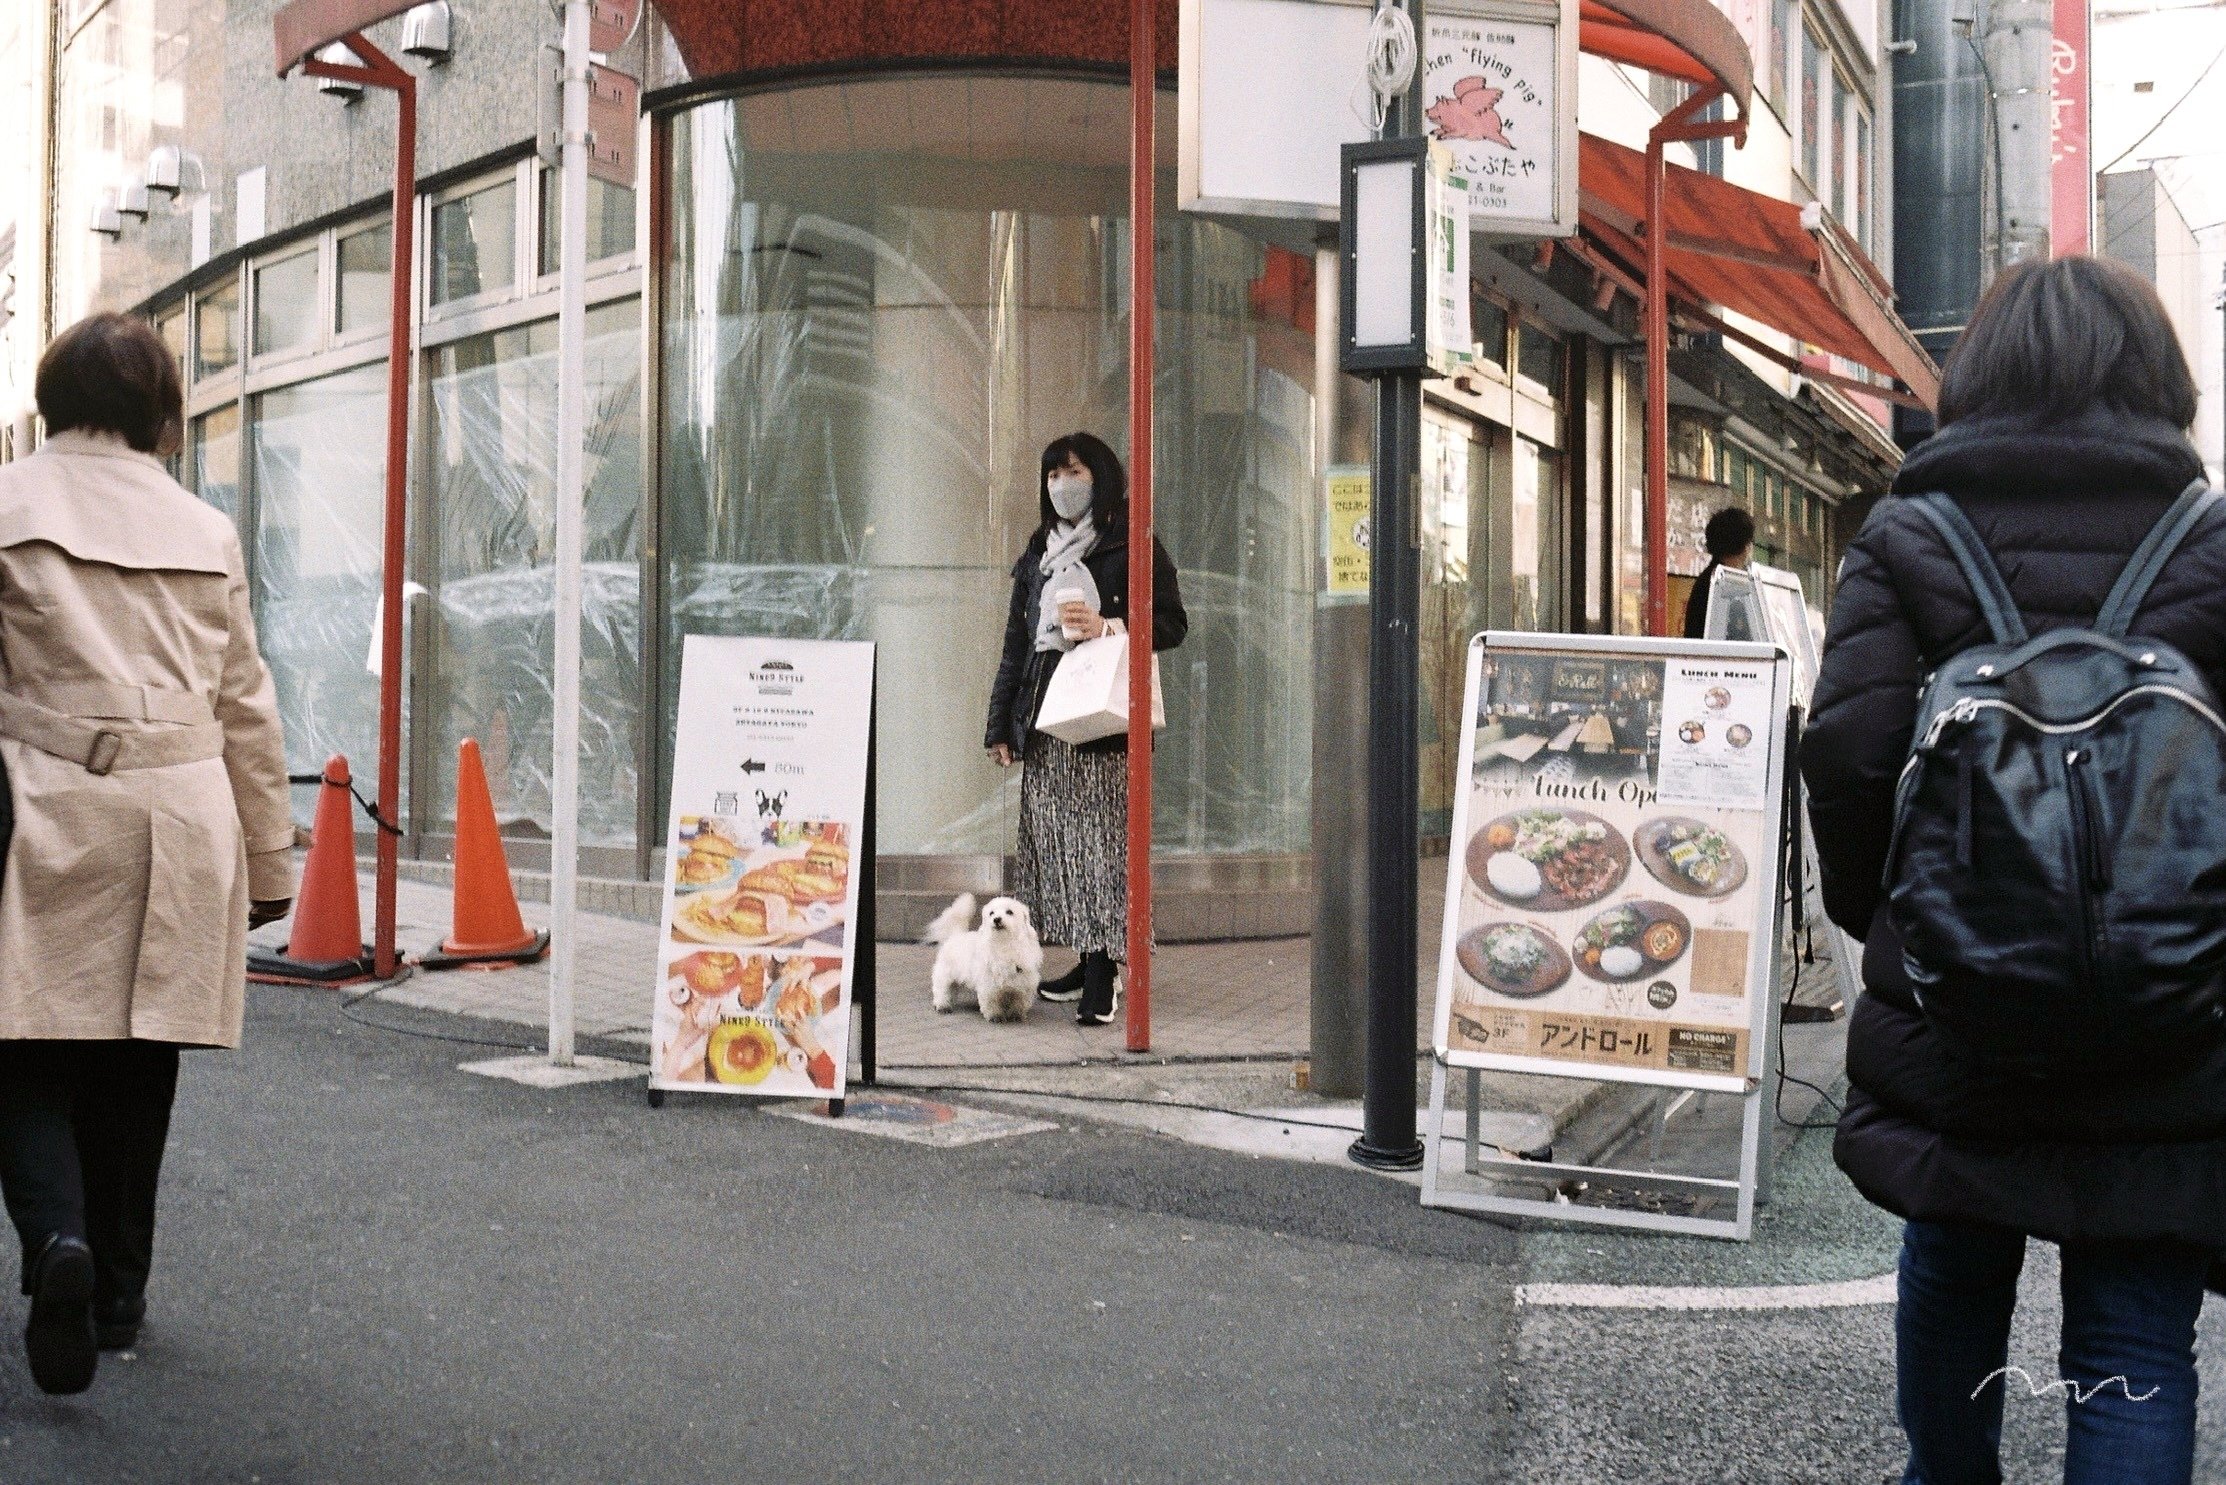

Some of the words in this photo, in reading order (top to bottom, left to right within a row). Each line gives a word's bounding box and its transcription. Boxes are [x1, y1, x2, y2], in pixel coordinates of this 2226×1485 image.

[1540, 1022, 1652, 1056] アンドロール
